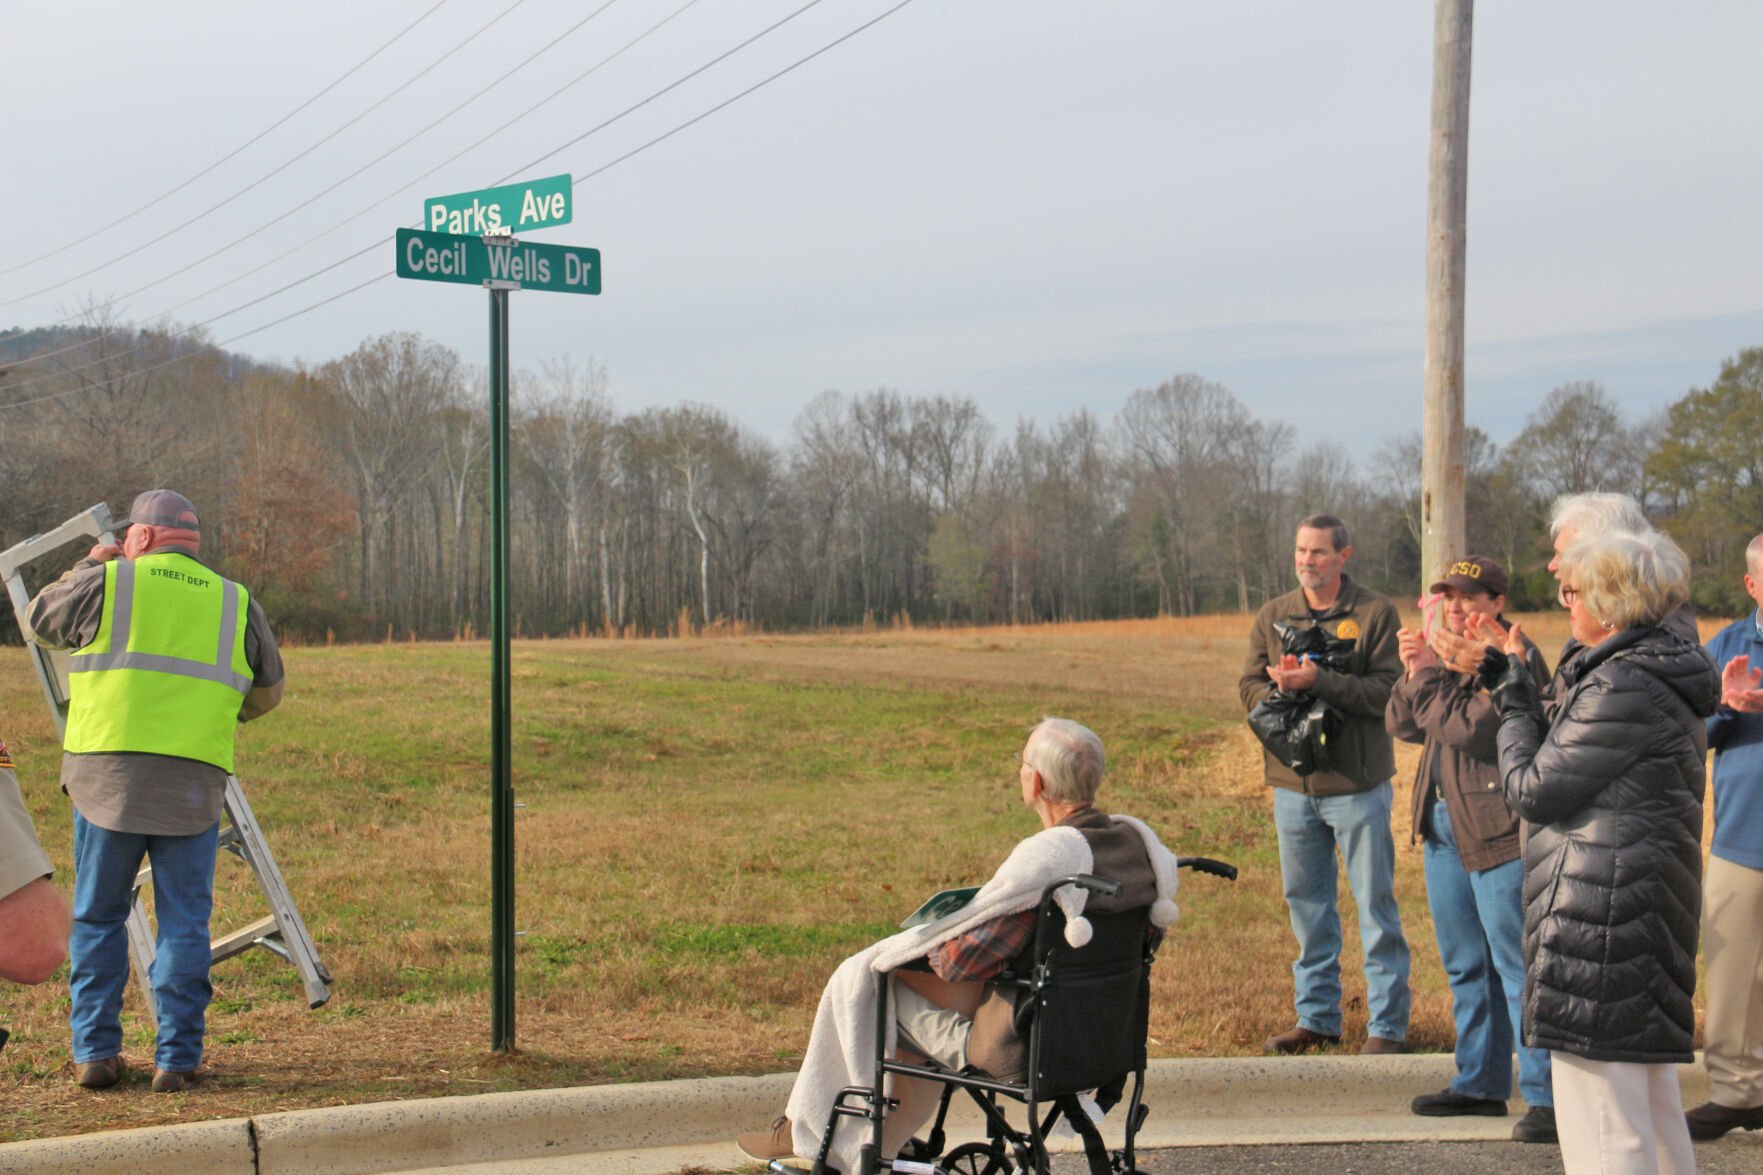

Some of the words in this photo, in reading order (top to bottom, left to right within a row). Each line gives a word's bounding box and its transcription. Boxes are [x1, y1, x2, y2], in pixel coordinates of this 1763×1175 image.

[431, 199, 502, 235] Parks
[520, 189, 565, 225] Ave
[406, 237, 467, 276] Cecil
[487, 244, 551, 284] Wells
[564, 252, 592, 286] Dr
[150, 568, 186, 582] STREET
[187, 576, 210, 588] DEPT
